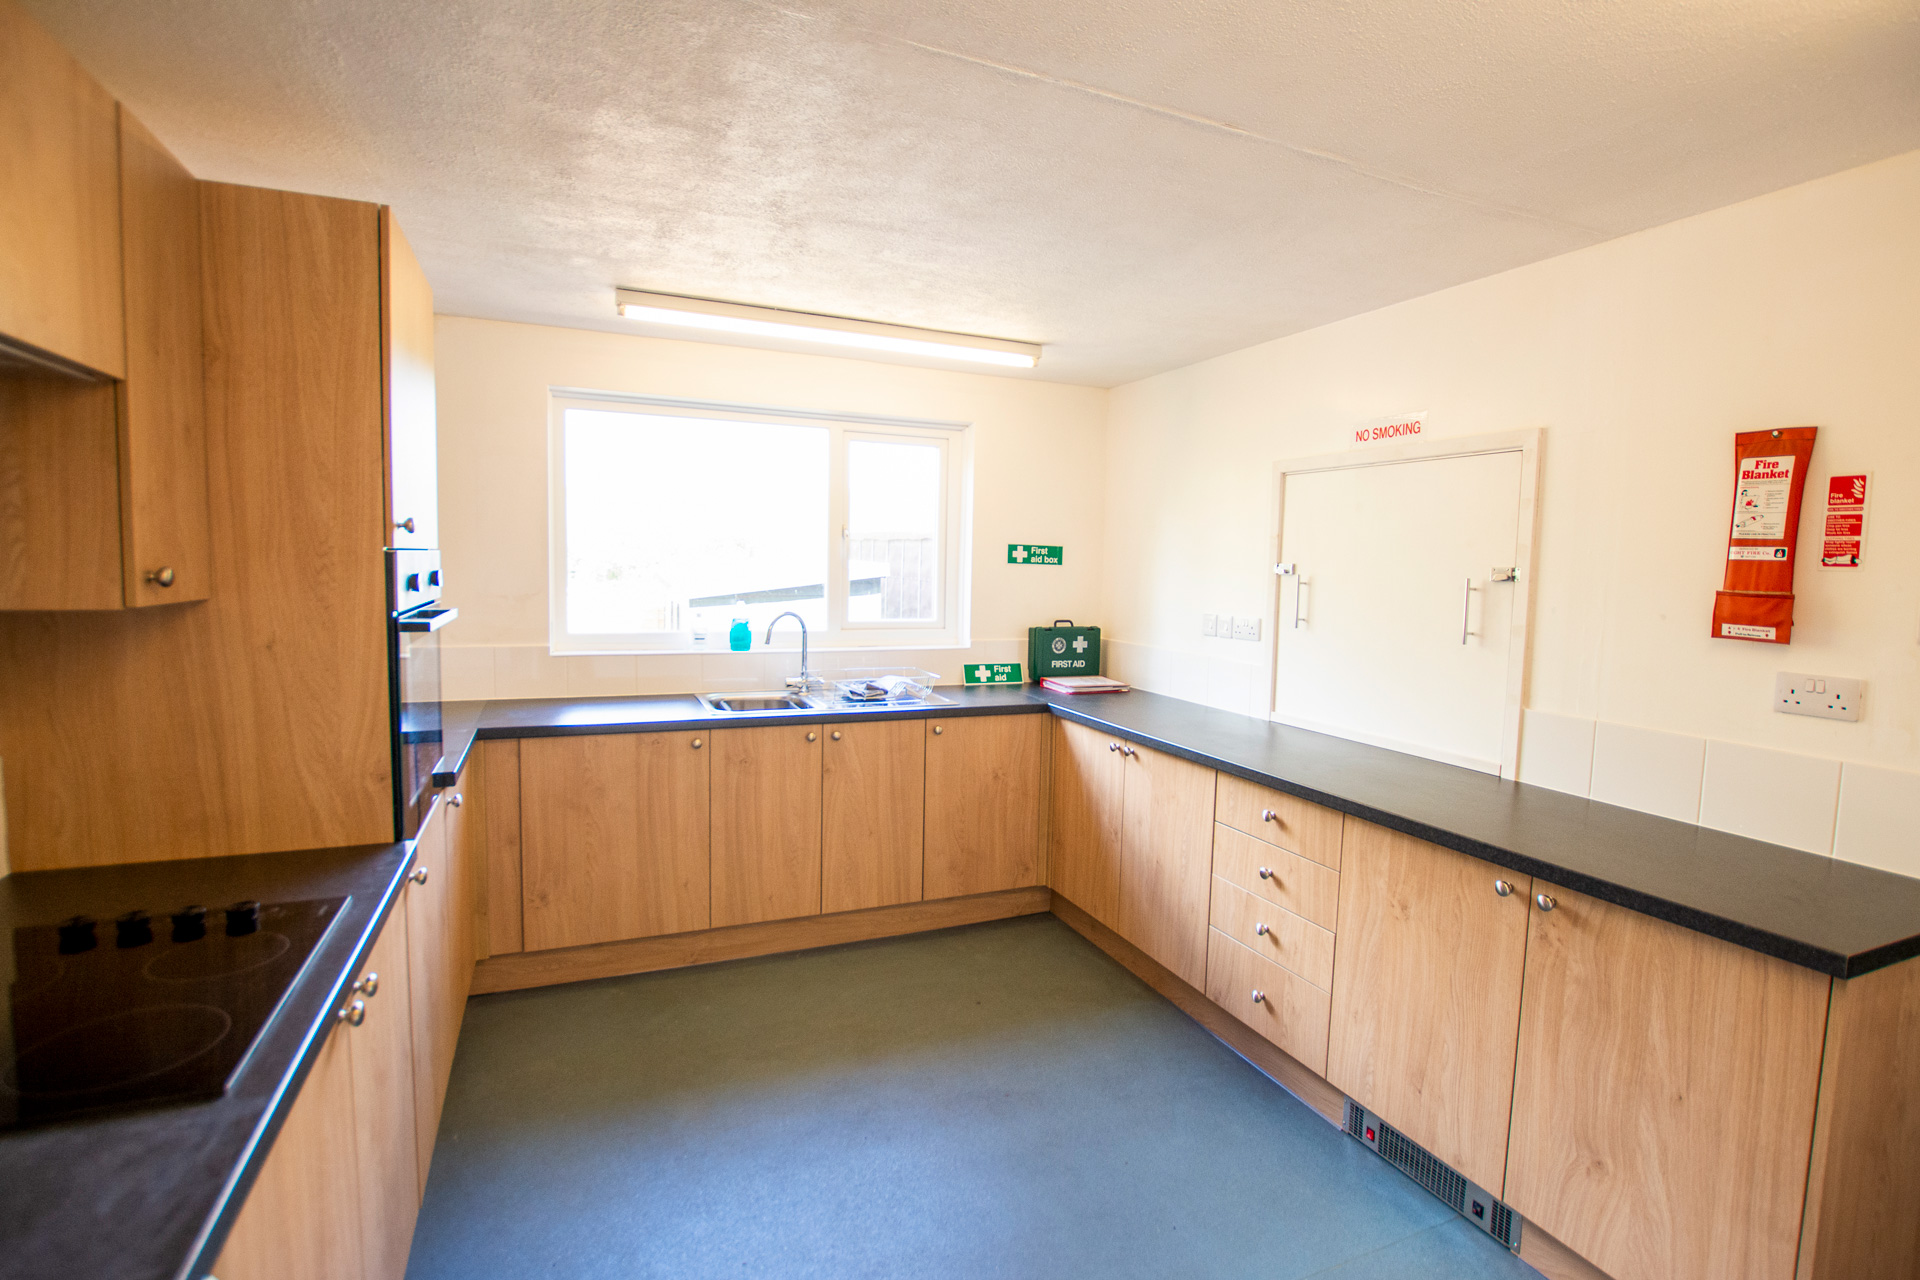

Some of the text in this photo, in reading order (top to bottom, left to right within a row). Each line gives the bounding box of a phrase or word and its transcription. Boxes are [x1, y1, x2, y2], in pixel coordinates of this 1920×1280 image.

[1355, 420, 1421, 442] NO SMOKING
[1755, 459, 1779, 470] Fire
[1741, 469, 1790, 480] Blanket
[1031, 546, 1048, 555] First
[1030, 555, 1058, 564] aid box
[1051, 660, 1086, 668] FIRST AID
[994, 665, 1011, 673] First
[995, 673, 1007, 681] aid
